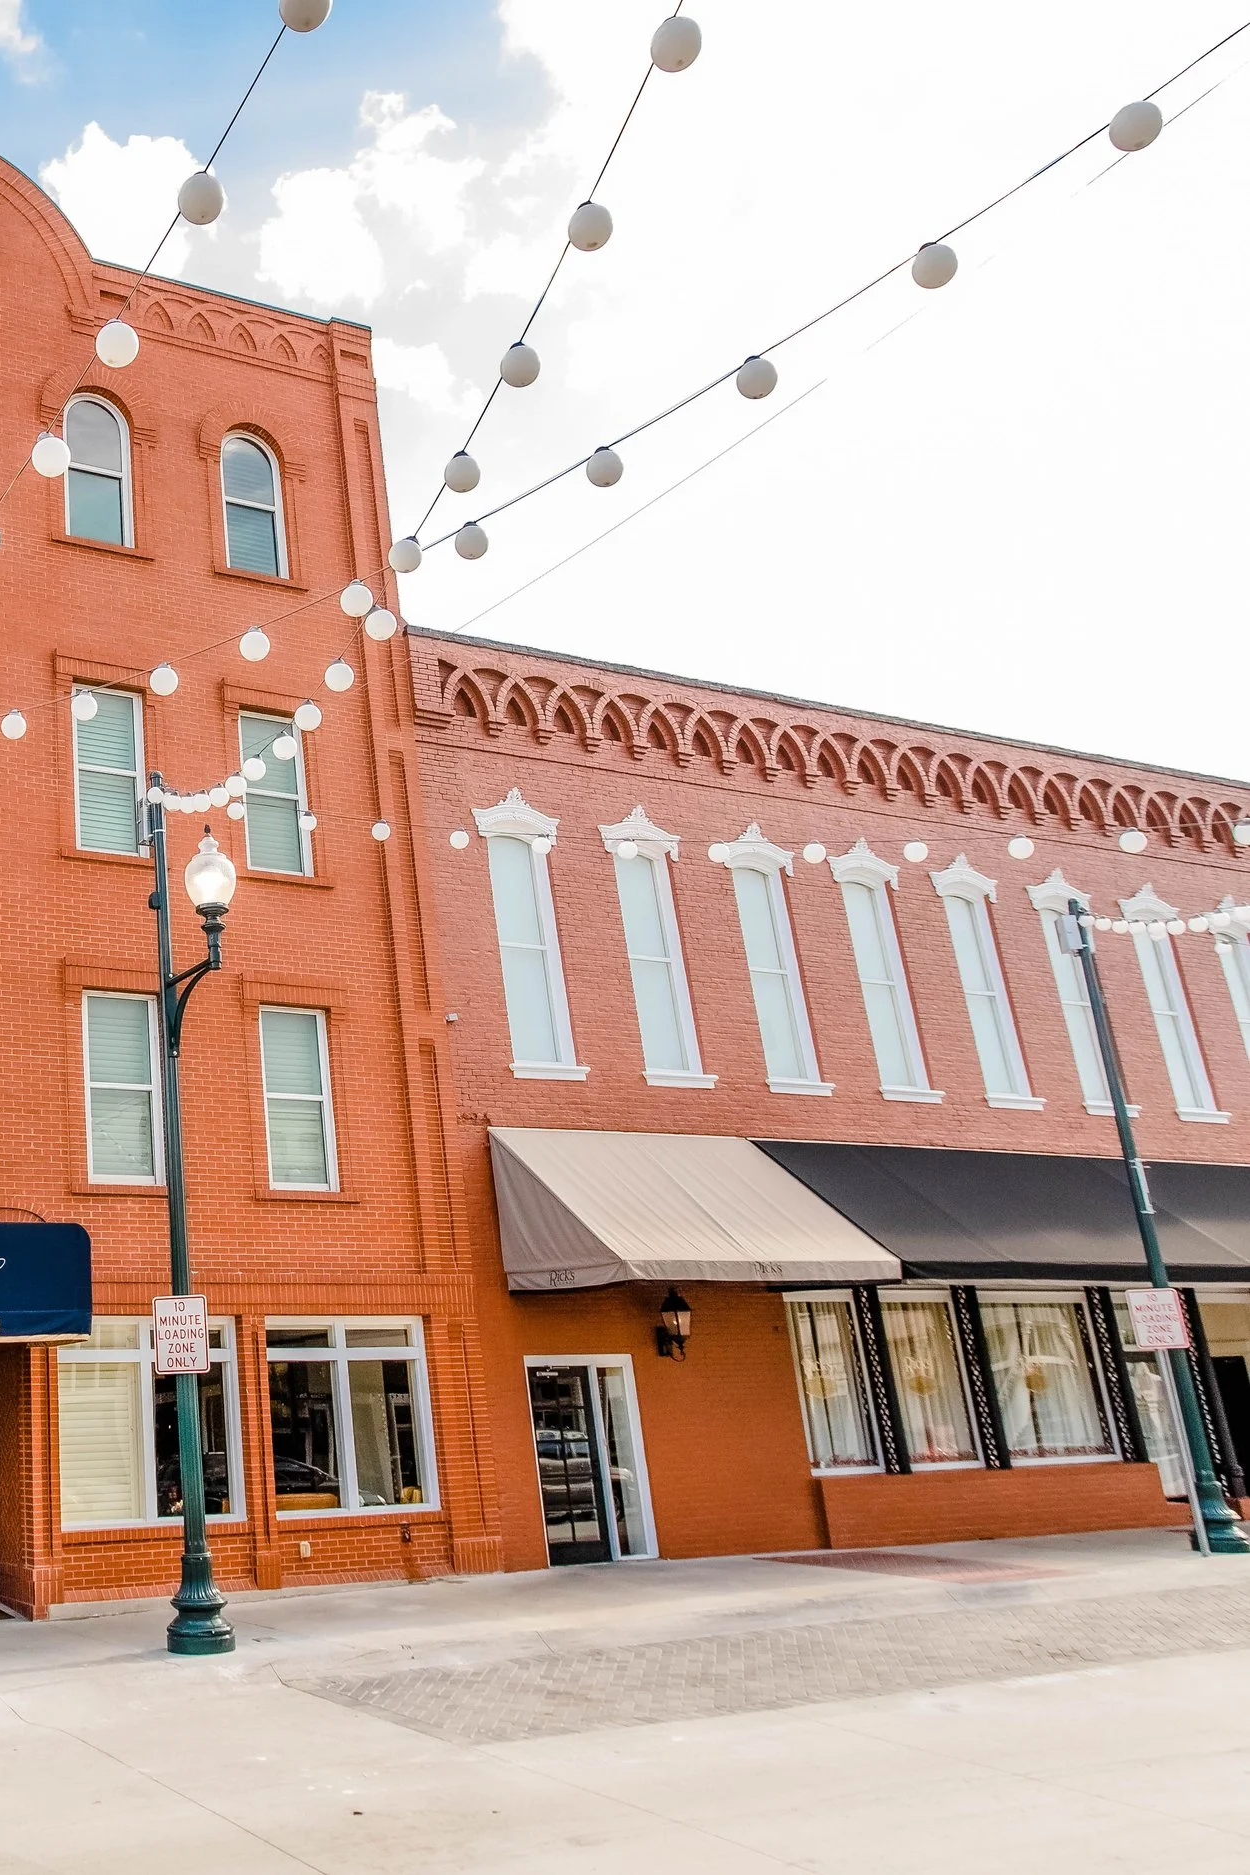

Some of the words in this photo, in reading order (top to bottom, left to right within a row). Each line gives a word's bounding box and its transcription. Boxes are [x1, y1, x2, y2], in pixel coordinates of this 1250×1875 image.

[1146, 1293, 1158, 1302] 10
[174, 1301, 185, 1312] 10
[1134, 1304, 1175, 1312] MINUTE
[159, 1315, 201, 1326] MINUTE
[1133, 1314, 1178, 1324] LOADING
[1145, 1324, 1173, 1333] ZONE
[158, 1328, 204, 1340] LOADING
[1147, 1335, 1175, 1344] ONLY
[168, 1343, 196, 1354] ZONE
[167, 1357, 197, 1368] ONLY
